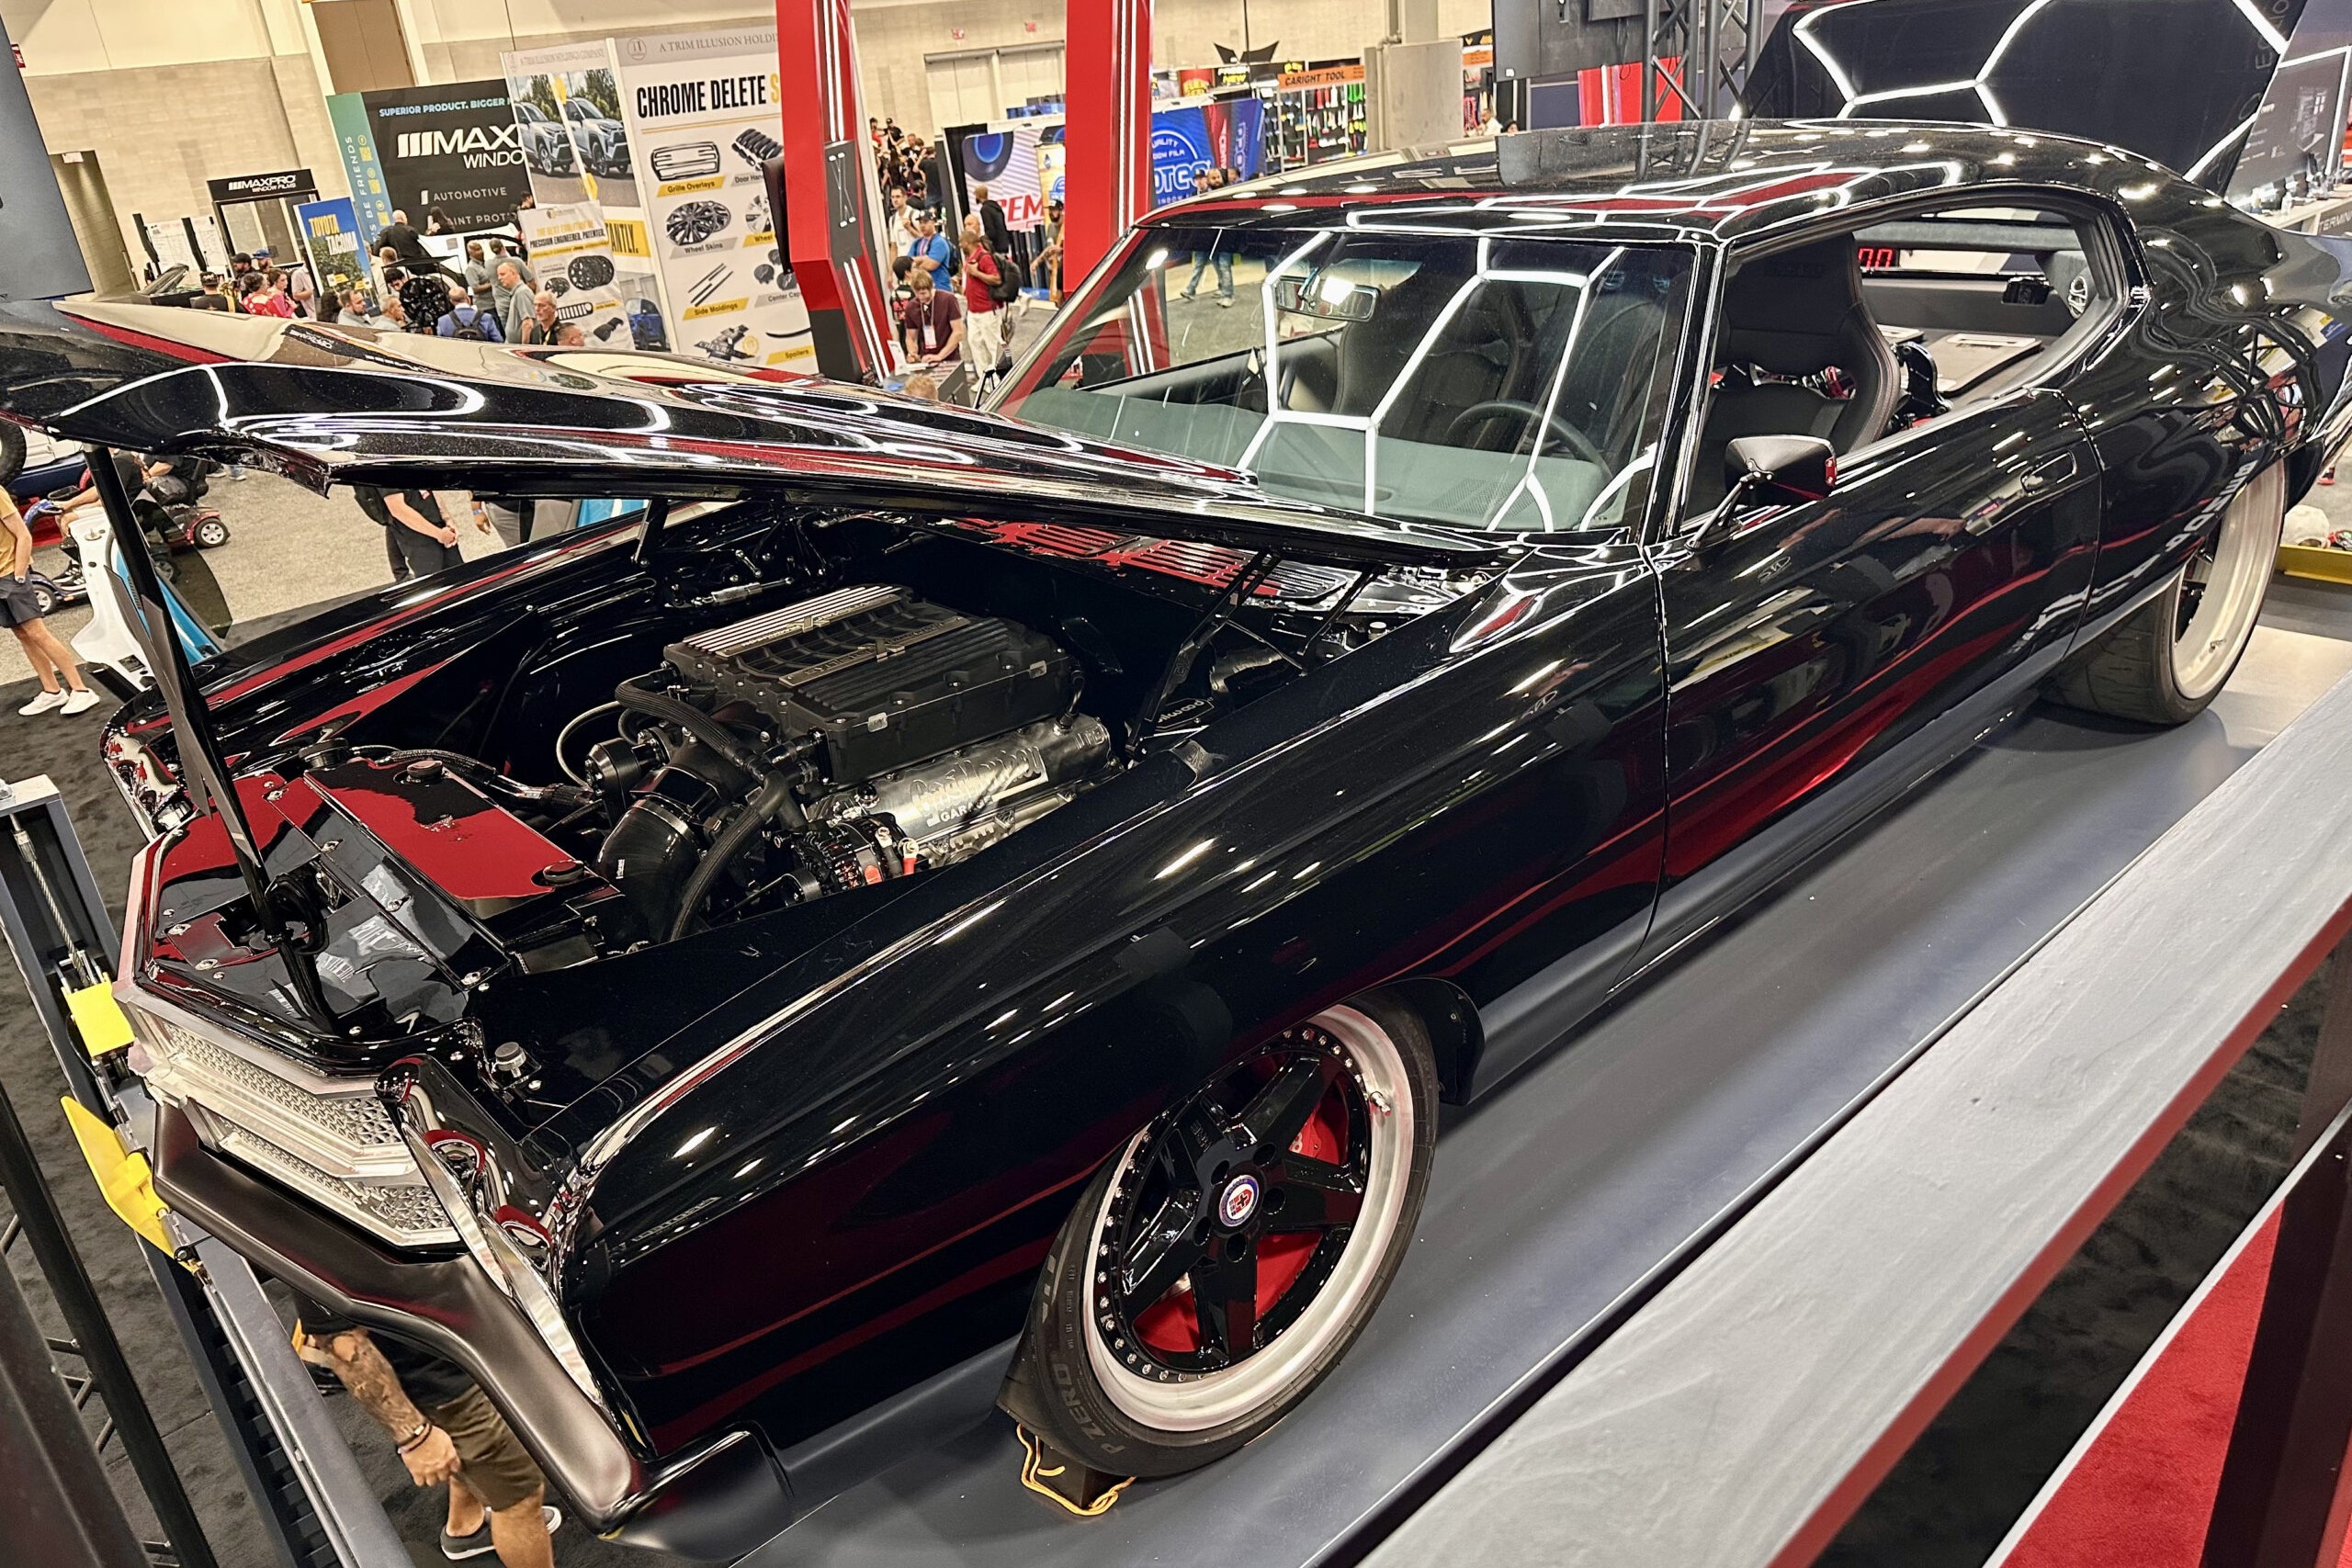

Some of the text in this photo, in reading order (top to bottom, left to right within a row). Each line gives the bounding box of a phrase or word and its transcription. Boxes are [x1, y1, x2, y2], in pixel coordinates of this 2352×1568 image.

[668, 40, 695, 51] TRIM
[695, 37, 742, 51] ILLUSION
[1284, 74, 1320, 86] CARIGHT
[1326, 72, 1345, 81] TOOL
[637, 80, 707, 118] CHROME
[710, 74, 766, 110] DELETE
[379, 101, 422, 118] SUPERIOR
[423, 101, 469, 116] PRODUCT.
[470, 97, 505, 109] BIGGER
[433, 123, 521, 154] MAX
[345, 136, 368, 196] FRIENDS
[463, 150, 526, 169] WINDO
[241, 174, 297, 190] MAXPRO
[252, 182, 297, 193] WINDOW FILMS
[667, 181, 715, 193] Grille Overlays
[433, 186, 508, 202] AUTOMOTIVE
[363, 202, 374, 219] BE
[309, 214, 340, 239] TOYOTA
[325, 231, 359, 256] TACOMA
[754, 234, 773, 243] Wheel
[684, 243, 723, 254] Wheel Skins
[768, 293, 788, 302] Center
[709, 302, 738, 314] Moldings
[785, 349, 808, 359] Spoilers
[940, 795, 992, 823] GARAGE
